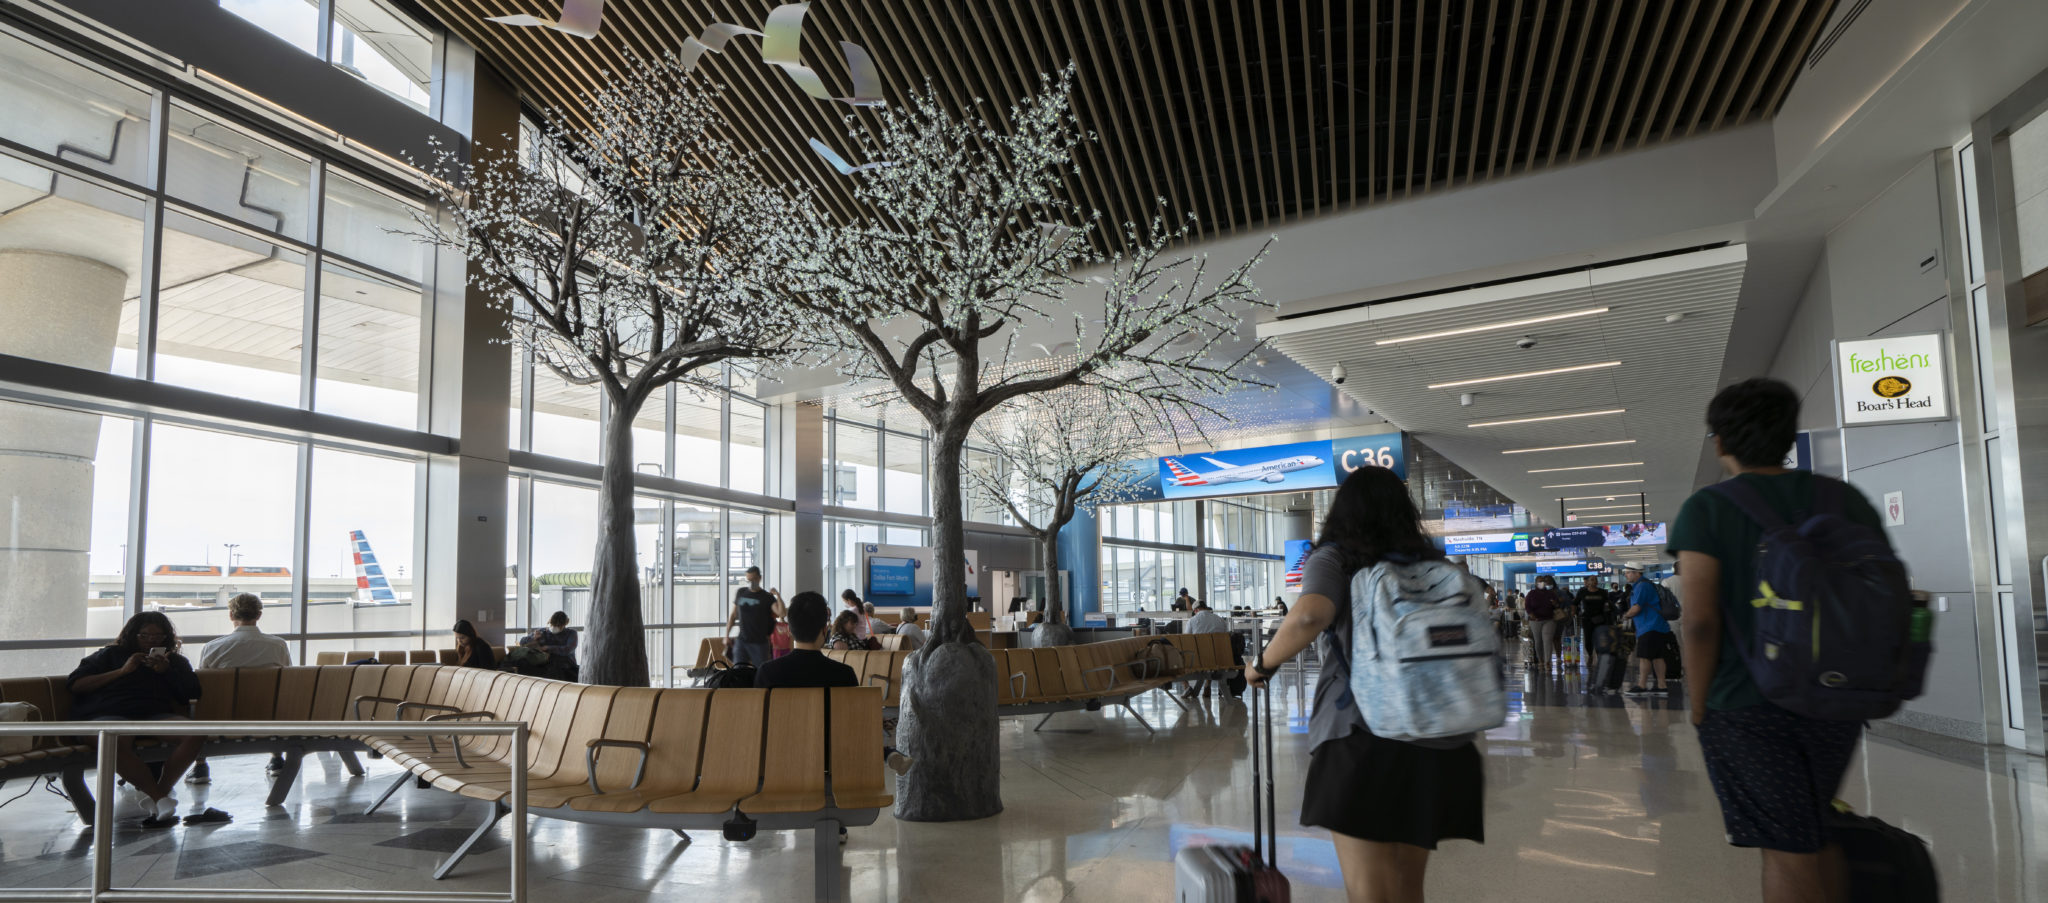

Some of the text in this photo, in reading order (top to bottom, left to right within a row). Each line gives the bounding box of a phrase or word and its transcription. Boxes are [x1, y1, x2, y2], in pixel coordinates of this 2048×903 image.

[1850, 348, 1929, 374] freshëns
[1857, 396, 1932, 412] Boar's Head
[1341, 446, 1395, 473] C36
[1261, 461, 1297, 473] American
[865, 544, 879, 553] C36
[1531, 536, 1545, 547] C3
